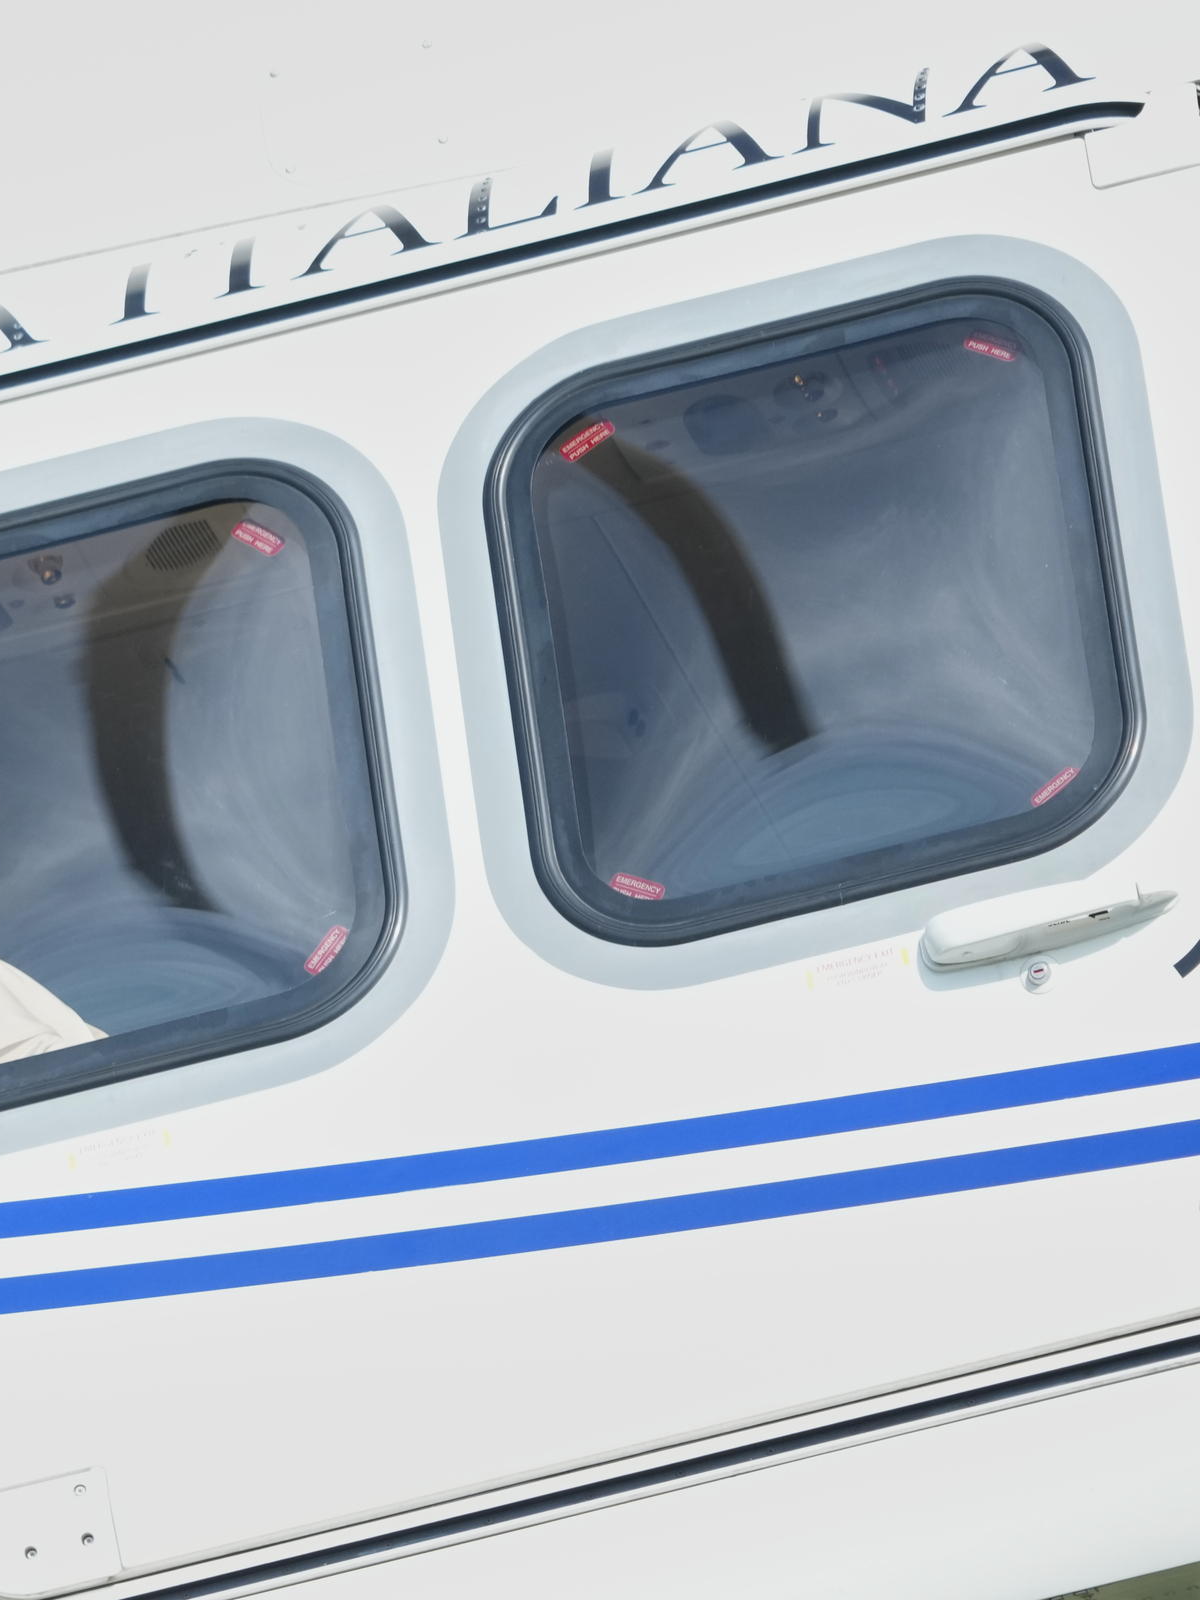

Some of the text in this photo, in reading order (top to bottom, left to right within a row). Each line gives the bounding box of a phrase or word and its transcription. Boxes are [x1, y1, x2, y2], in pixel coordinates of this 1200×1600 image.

[108, 42, 1097, 326] ITALIANA
[968, 340, 1011, 359] PUSH HERE
[562, 422, 604, 454] EMERGENCY
[569, 429, 610, 460] PUSH HERE
[235, 529, 274, 554] PUSH HERE
[242, 521, 281, 546] EMERGENCY
[1034, 767, 1075, 804] EMERGENCY
[615, 875, 661, 894] EMERGENCY
[307, 928, 341, 969] EMERGENCY
